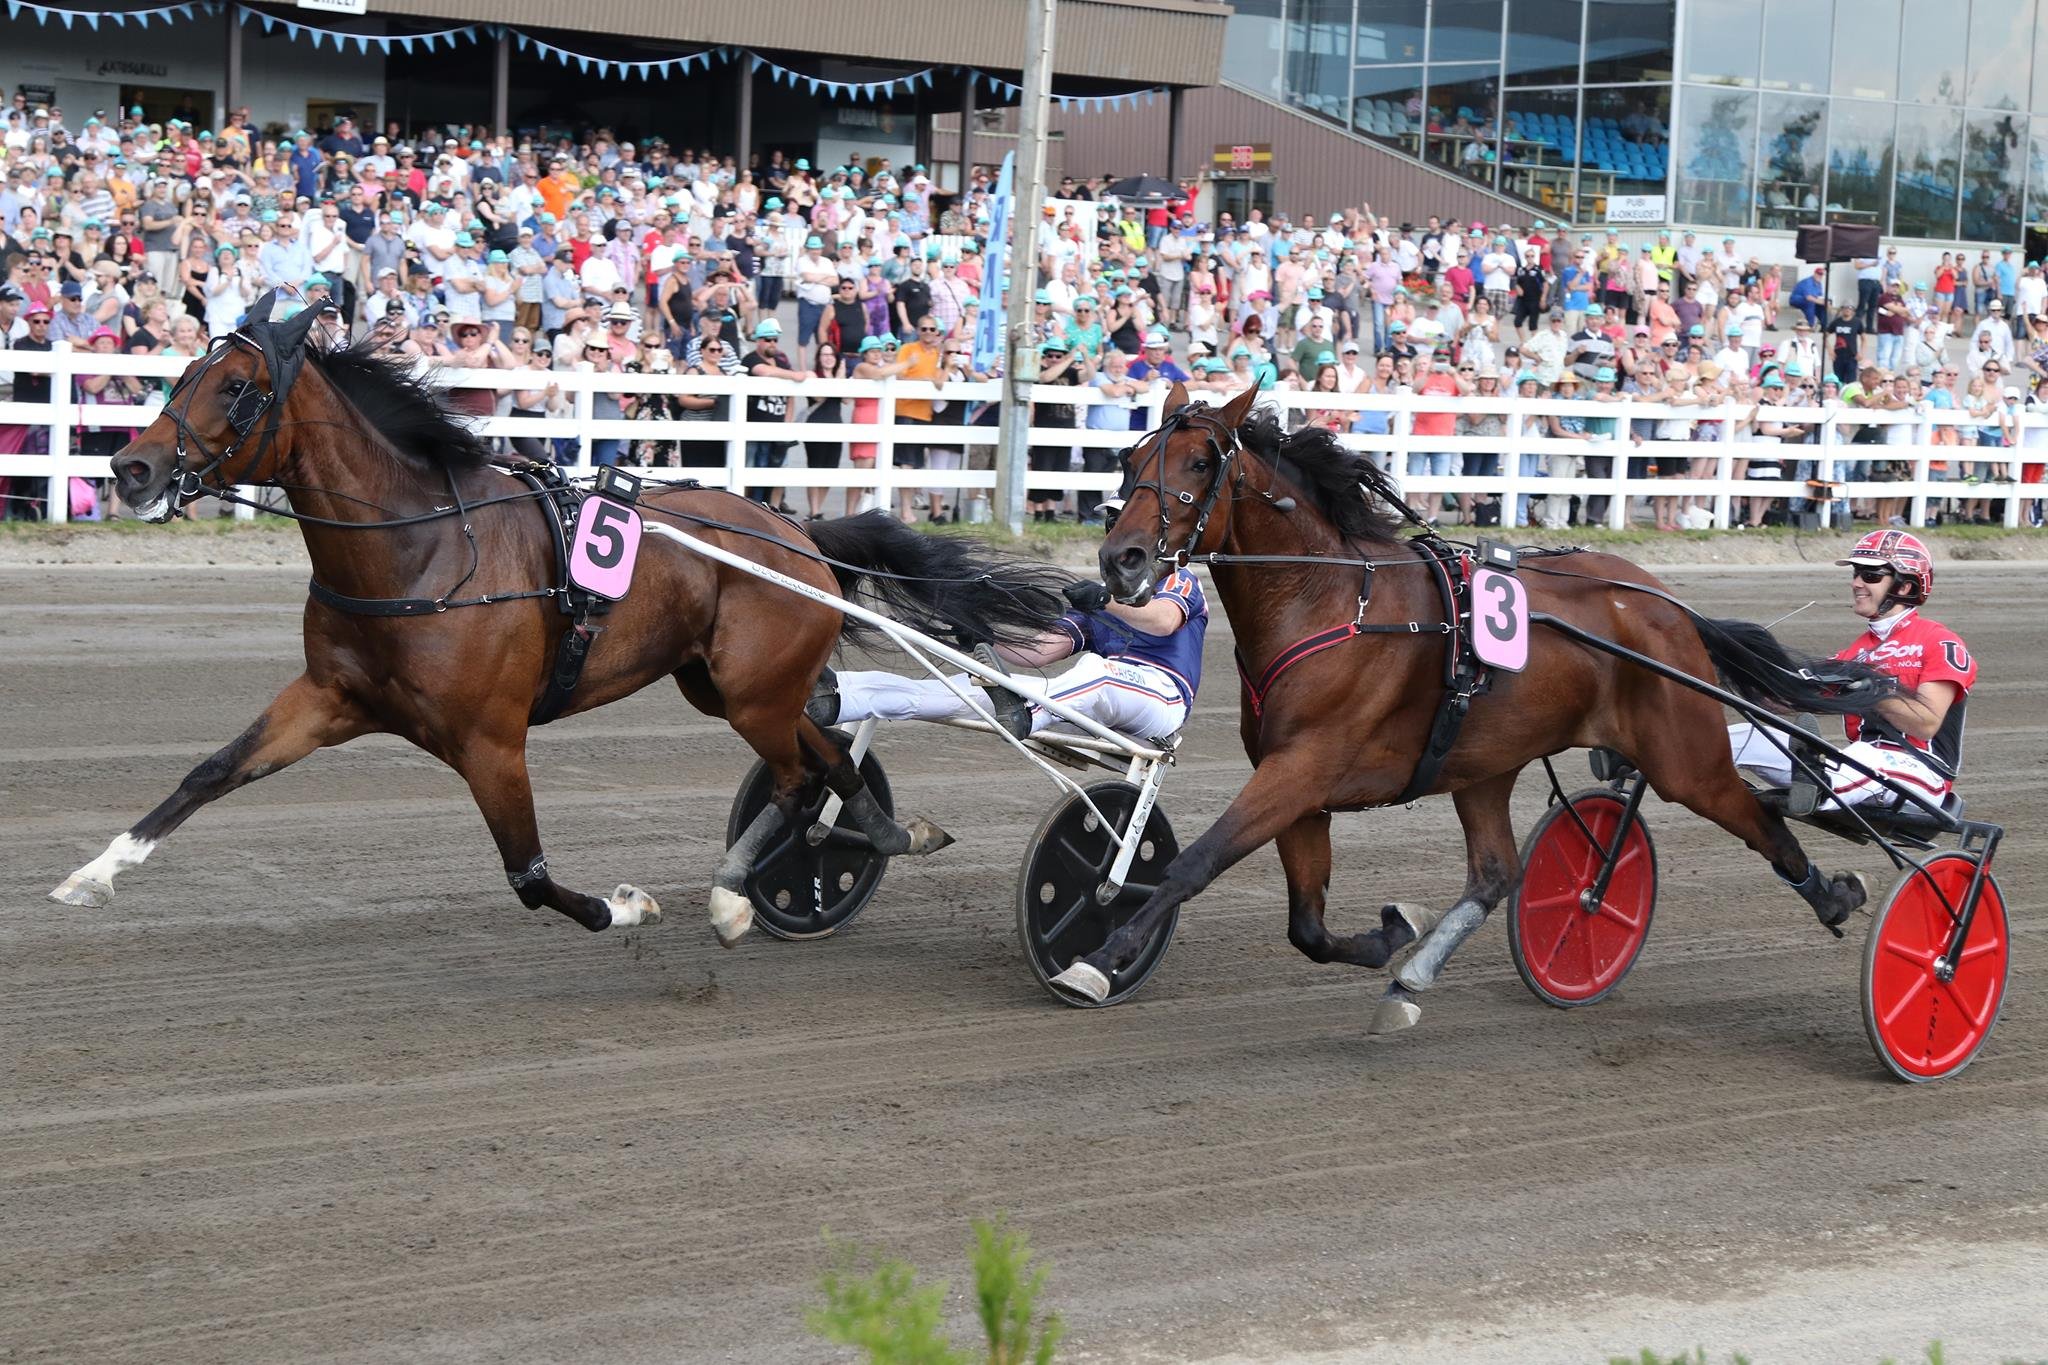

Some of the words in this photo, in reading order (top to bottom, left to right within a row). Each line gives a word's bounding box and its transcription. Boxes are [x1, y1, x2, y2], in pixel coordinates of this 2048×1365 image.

[585, 500, 631, 569] 5
[1484, 574, 1518, 642] 3
[1939, 640, 1971, 674] U
